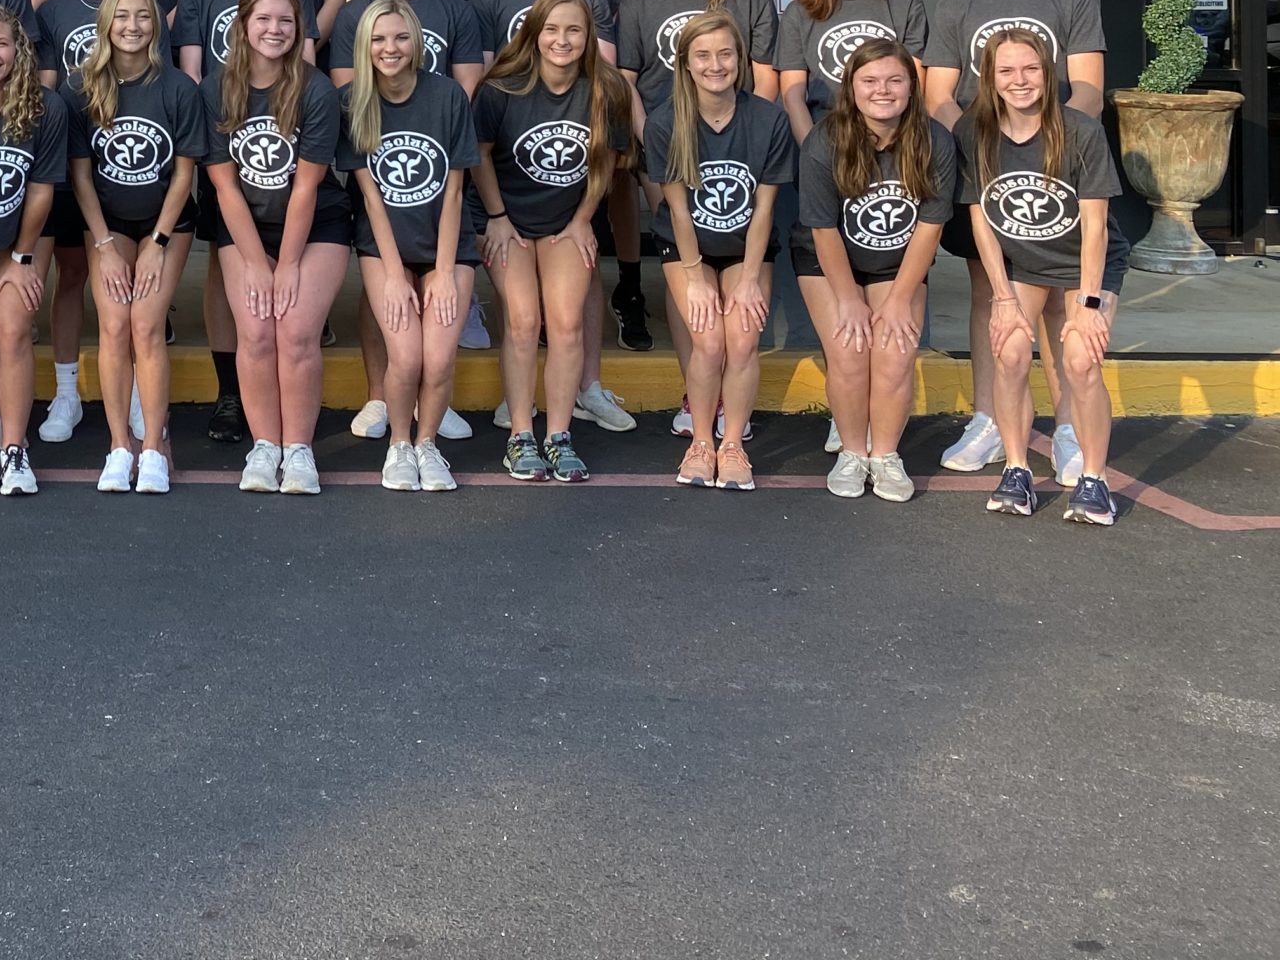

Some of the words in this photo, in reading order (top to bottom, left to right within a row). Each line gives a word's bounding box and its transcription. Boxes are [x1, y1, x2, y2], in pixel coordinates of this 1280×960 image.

[230, 120, 299, 149] absolue
[372, 135, 438, 165] bsolute
[692, 206, 753, 230] fitness
[1001, 216, 1074, 238] fitness
